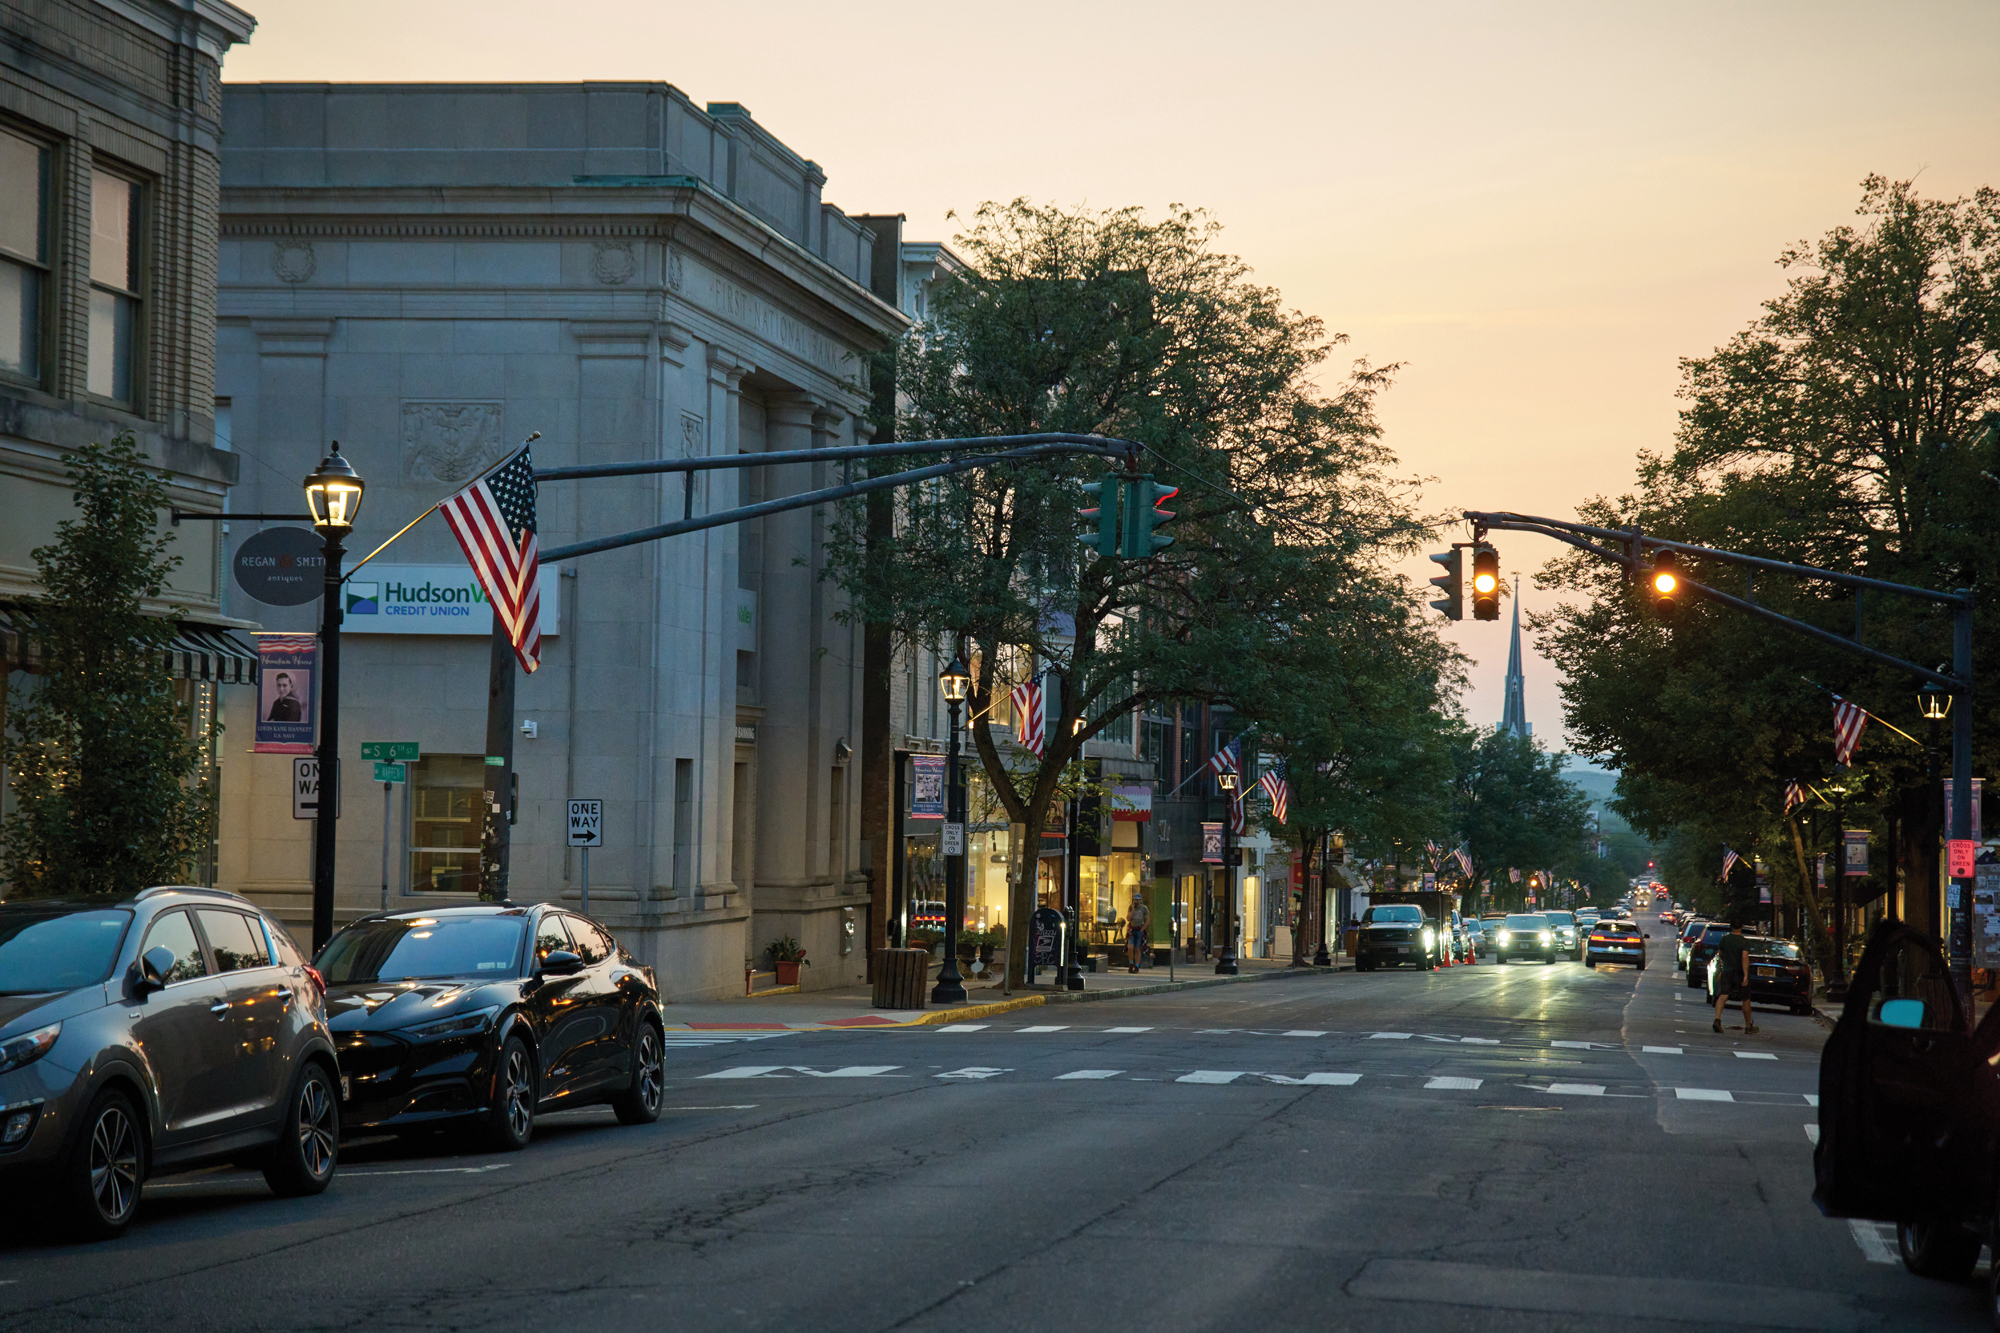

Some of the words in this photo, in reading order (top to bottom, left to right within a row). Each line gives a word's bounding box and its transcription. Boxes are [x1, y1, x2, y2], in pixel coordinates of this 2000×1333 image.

[715, 279, 747, 320] FIRST
[754, 301, 806, 354] NATIONAL
[810, 334, 837, 370] BANK
[241, 557, 275, 567] REGAN
[296, 557, 326, 567] SMIT
[267, 575, 303, 583] antiques
[385, 581, 490, 604] HudsonV
[385, 606, 426, 616] CREDIT
[430, 606, 470, 616] UNION
[373, 745, 380, 757] S
[300, 763, 320, 778] ON
[299, 780, 320, 795] WA
[571, 803, 598, 815] ONE
[571, 816, 599, 828] WAY
